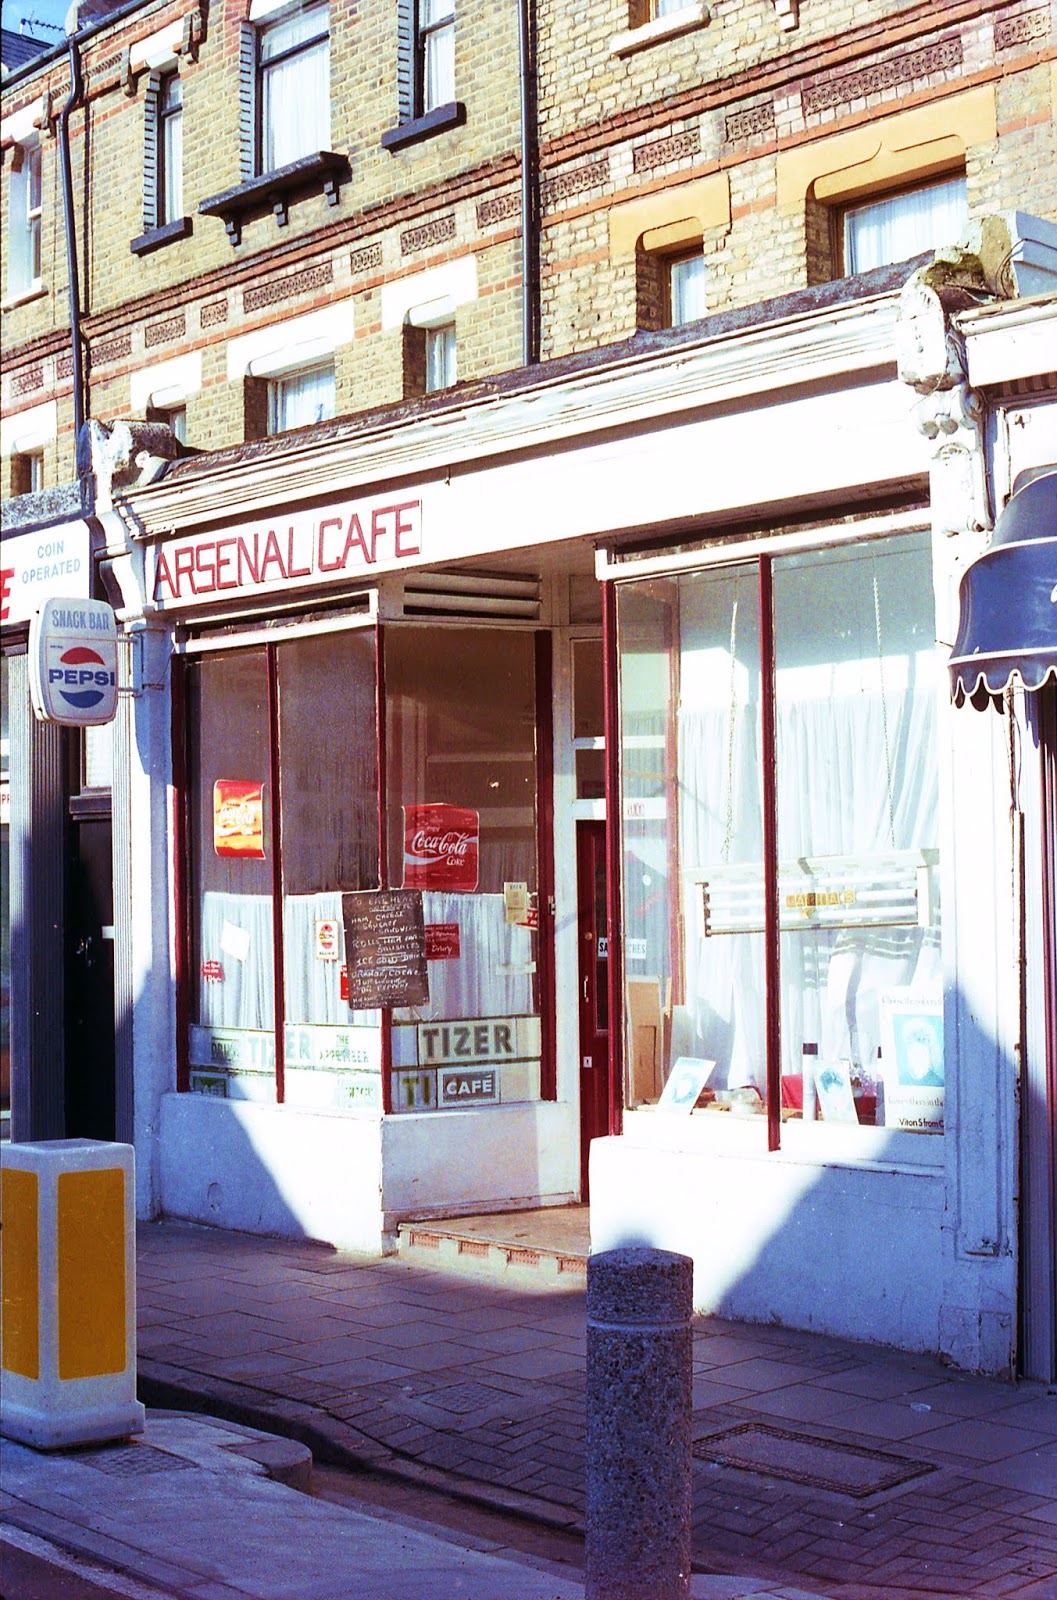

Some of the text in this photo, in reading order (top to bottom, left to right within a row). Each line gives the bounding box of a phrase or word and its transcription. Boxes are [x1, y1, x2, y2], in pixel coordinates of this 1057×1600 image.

[37, 540, 64, 559] COIN
[154, 500, 420, 598] ARSENAL CAFE
[22, 558, 80, 584] OPERATED
[52, 609, 109, 631] SNACK BAR
[49, 668, 115, 687] PEPSI
[411, 830, 469, 855] Coca-Cola
[446, 856, 465, 866] Coke
[422, 1024, 515, 1058] TIZER
[402, 1075, 431, 1108] TI
[446, 1074, 493, 1095] CAFÉ
